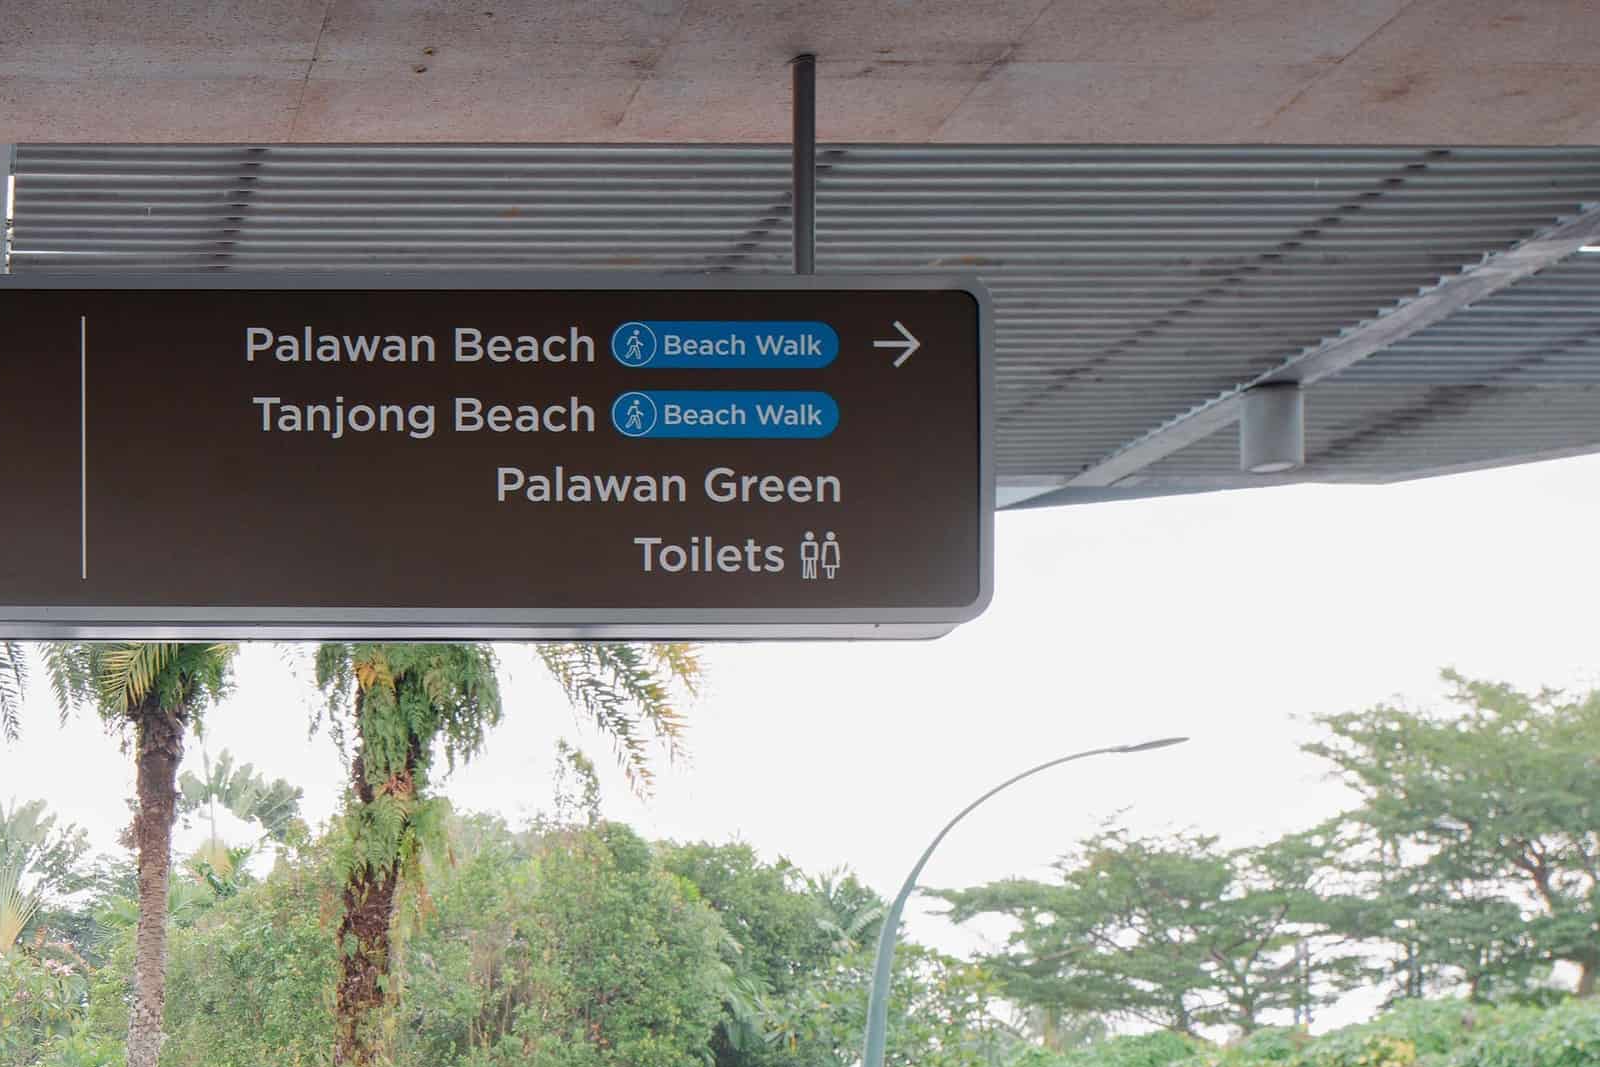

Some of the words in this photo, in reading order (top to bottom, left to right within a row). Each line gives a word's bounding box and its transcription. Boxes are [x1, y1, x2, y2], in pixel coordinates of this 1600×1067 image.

[246, 325, 436, 362] Palawan
[455, 326, 595, 363] Beach
[663, 333, 746, 356] Beach
[755, 333, 822, 356] Walk
[252, 396, 435, 439] Tanjong
[455, 396, 595, 433] Beach
[664, 403, 746, 426] Beach
[755, 403, 822, 426] Walk
[497, 465, 686, 503] Palawan
[704, 467, 841, 503] Green
[633, 535, 785, 573] Toilets
